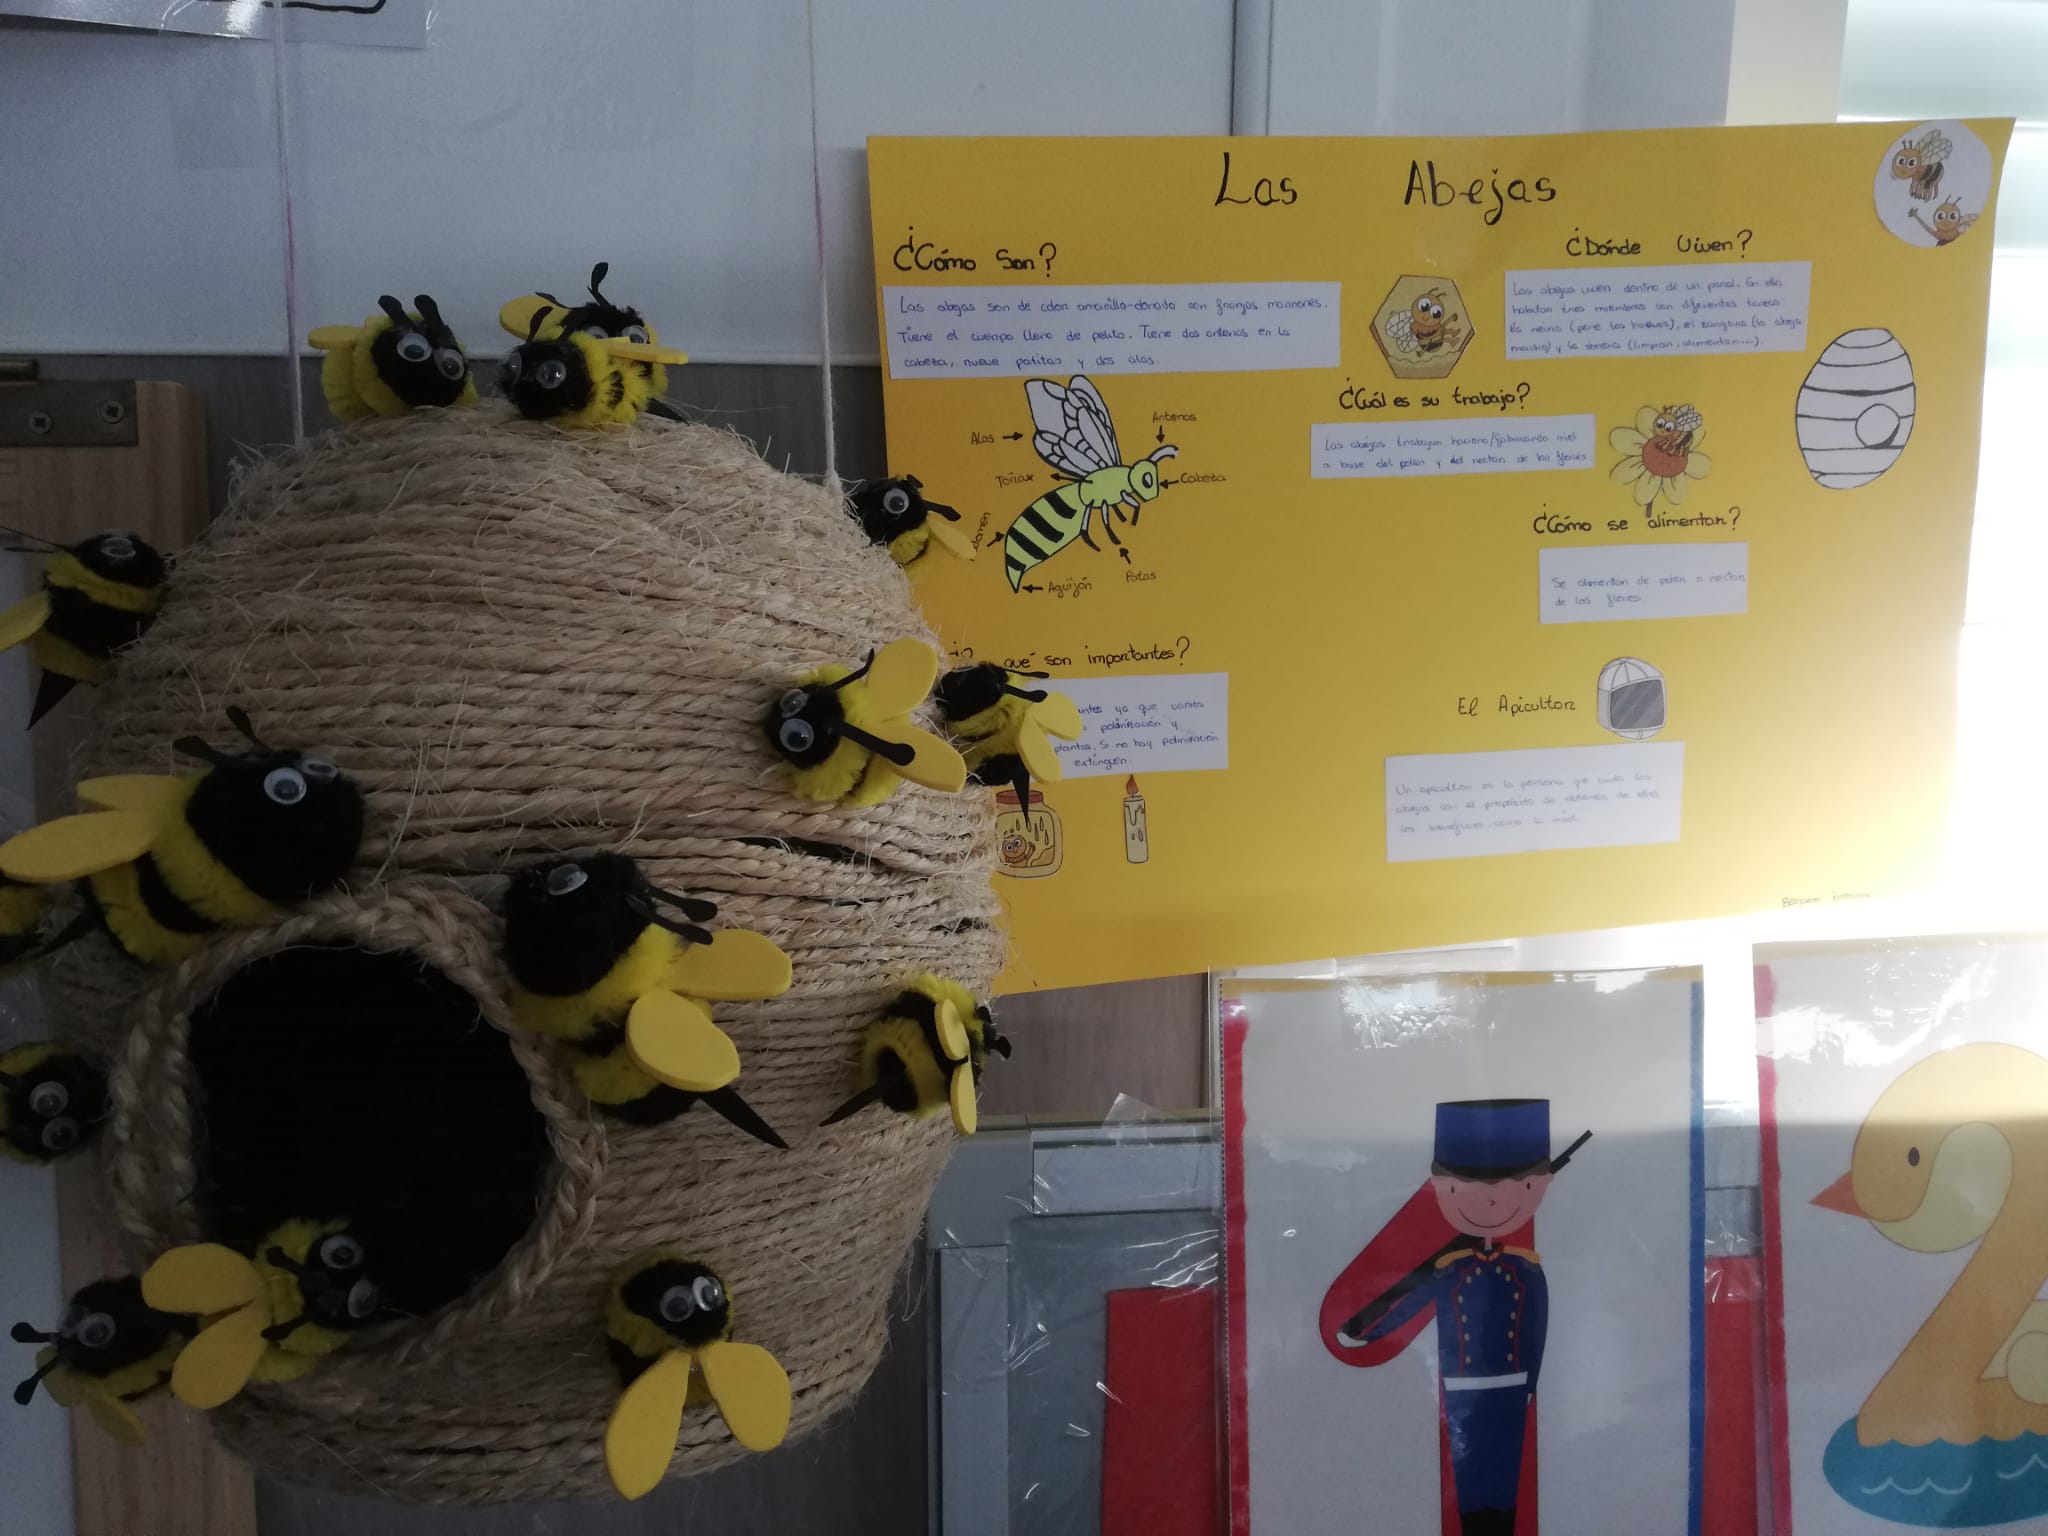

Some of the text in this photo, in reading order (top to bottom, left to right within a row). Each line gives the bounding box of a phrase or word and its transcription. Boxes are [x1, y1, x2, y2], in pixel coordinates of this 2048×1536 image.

[1214, 151, 1558, 225] Las Abejas
[892, 226, 977, 272] ¿Cómo
[1565, 227, 1642, 257] ¿Dónde
[1512, 281, 1534, 297] Las
[1539, 282, 1576, 300] abejas
[1664, 281, 1679, 293] de
[899, 295, 926, 314] Las
[936, 300, 977, 317] abejas
[987, 301, 1011, 313] son
[1017, 300, 1032, 312] de
[1040, 299, 1069, 312] color
[1187, 301, 1208, 311] con
[896, 325, 934, 344] Tiene
[946, 328, 959, 342] el
[970, 331, 1015, 345] cuerpo
[1022, 329, 1053, 343] lleno
[1065, 330, 1082, 343] de
[1139, 323, 1173, 340] Tiene
[1181, 327, 1201, 339] dos
[1257, 327, 1272, 338] en
[1277, 325, 1292, 338] la
[1077, 358, 1085, 370] y
[1095, 355, 1116, 367] dos
[1392, 395, 1411, 408] es
[1420, 395, 1441, 407] su
[1451, 381, 1532, 412] trabajo?
[970, 431, 996, 446] Alas
[1324, 439, 1344, 452] Las
[1179, 470, 1228, 484] Cabeza
[1532, 502, 1742, 535] ¿Cómo se alimentan?
[969, 511, 992, 554] domen
[1125, 569, 1157, 583] Patas
[1551, 577, 1567, 590] Se
[1043, 654, 1073, 667] son
[1084, 635, 1191, 667] importantes?
[1114, 704, 1129, 717] ya
[1138, 702, 1158, 717] que
[1457, 693, 1577, 718] El Apicultor
[1170, 719, 1179, 731] y
[1115, 741, 1129, 750] no
[1133, 738, 1153, 750] hay
